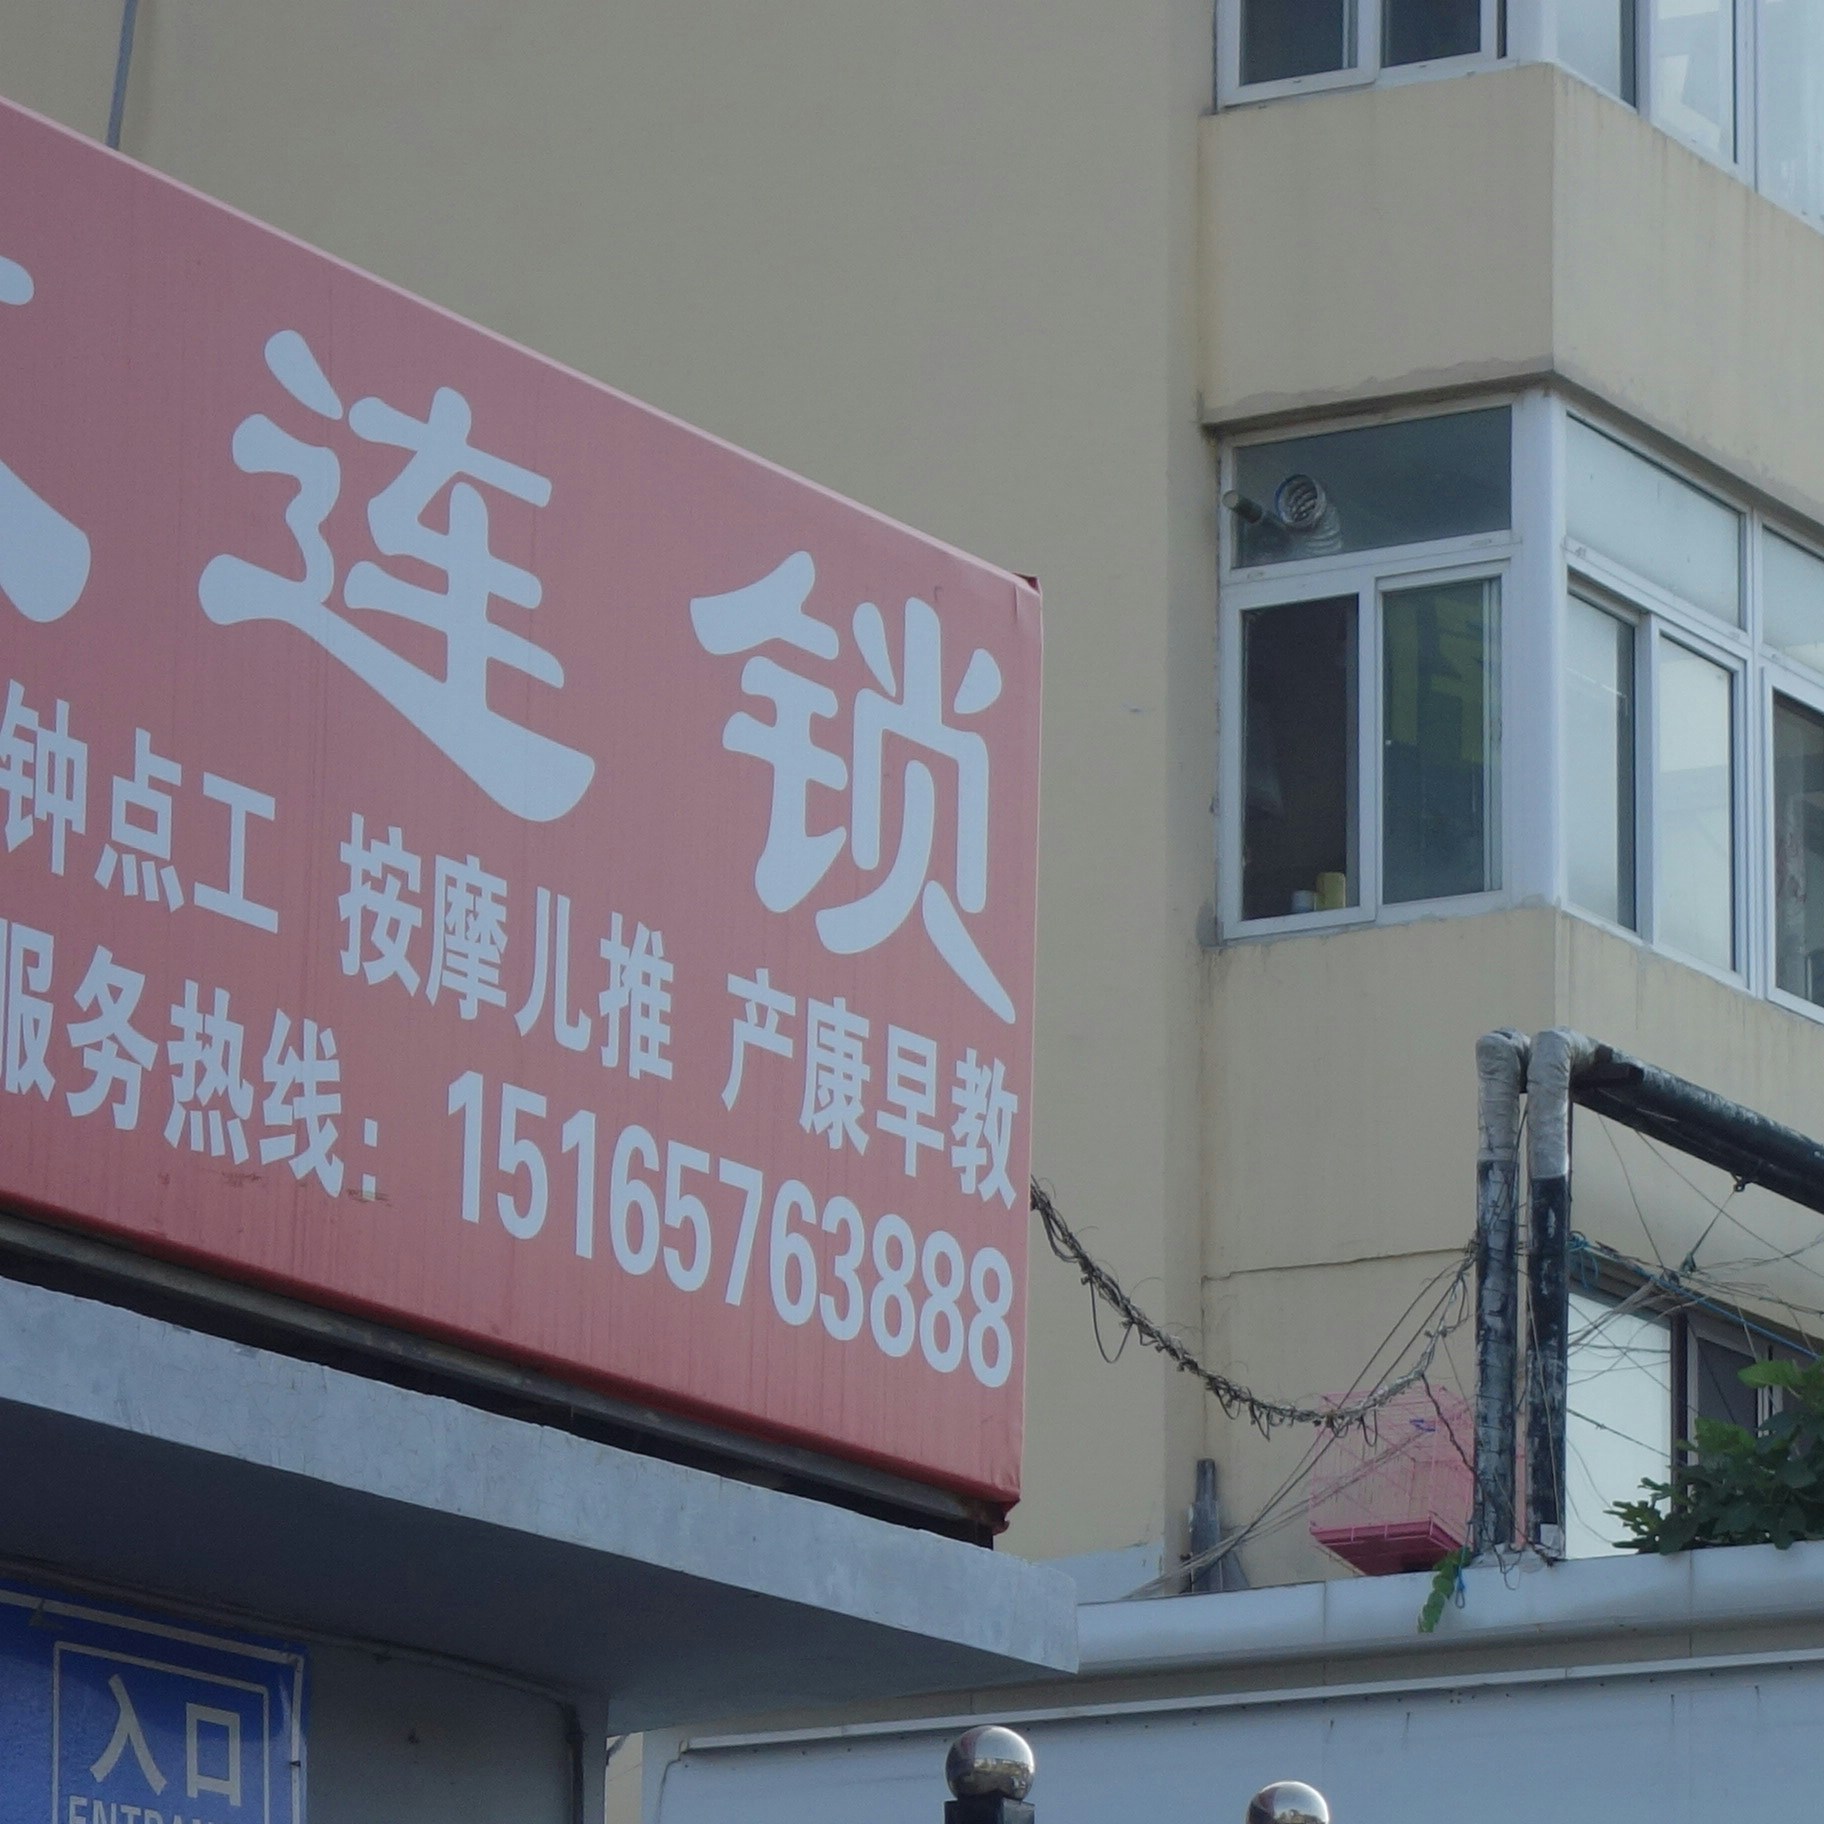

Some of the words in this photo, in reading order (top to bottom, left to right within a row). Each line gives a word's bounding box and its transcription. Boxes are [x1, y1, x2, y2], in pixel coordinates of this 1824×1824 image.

[0, 678, 278, 934] 钟点工
[338, 812, 674, 1081] 按摩儿推
[721, 967, 1019, 1210] 产康早教
[447, 1070, 1015, 1388] 15165763888
[90, 1673, 242, 1807] 入口
